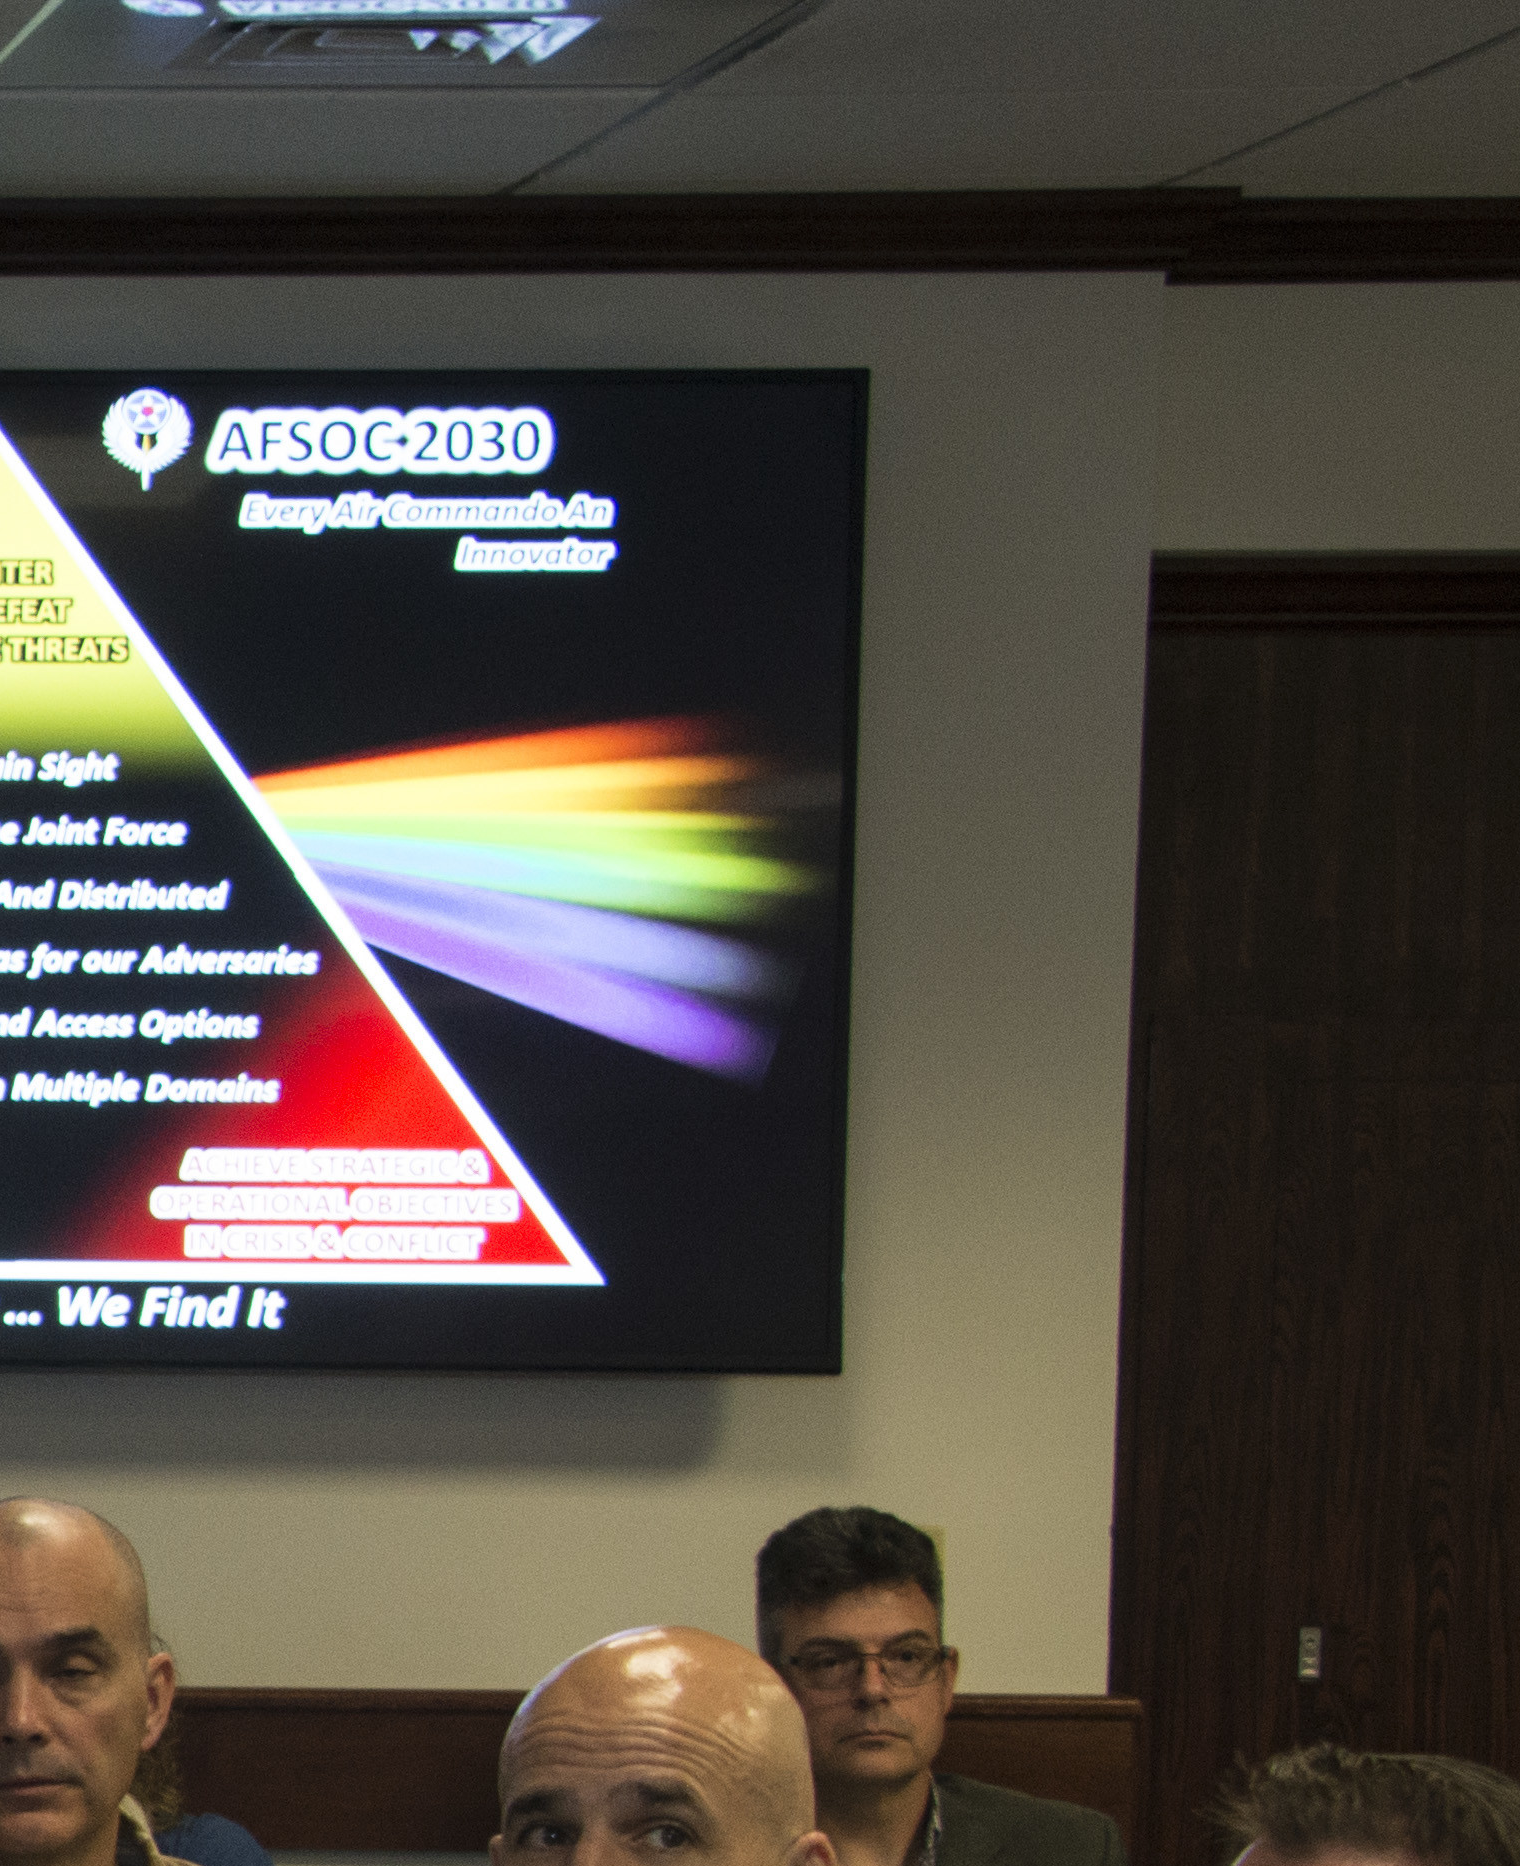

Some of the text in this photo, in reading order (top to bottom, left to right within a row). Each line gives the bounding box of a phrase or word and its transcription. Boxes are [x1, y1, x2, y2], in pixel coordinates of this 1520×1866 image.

[242, 493, 612, 529] Every Air Commando An
[458, 538, 612, 569] Innovator
[8, 636, 129, 664] THREATS
[38, 751, 118, 787] Sight
[22, 815, 99, 845] Joint
[103, 817, 187, 845] Force
[58, 880, 229, 910] Distributed
[27, 943, 79, 979] for
[82, 951, 137, 973] our
[138, 945, 318, 974] Adversaries
[32, 1009, 135, 1038] Access
[139, 1009, 259, 1044] Options
[11, 1071, 140, 1107] Multiple
[144, 1073, 280, 1103] Domains
[183, 1150, 456, 1182] ACHIEVE STRATEGIC
[152, 1188, 516, 1220] OPERATIONAL OBJECTIVES
[186, 1227, 481, 1257] IN CRISIS CONFLICT
[58, 1286, 130, 1327] We
[140, 1285, 240, 1328] Find
[247, 1288, 285, 1329] It
